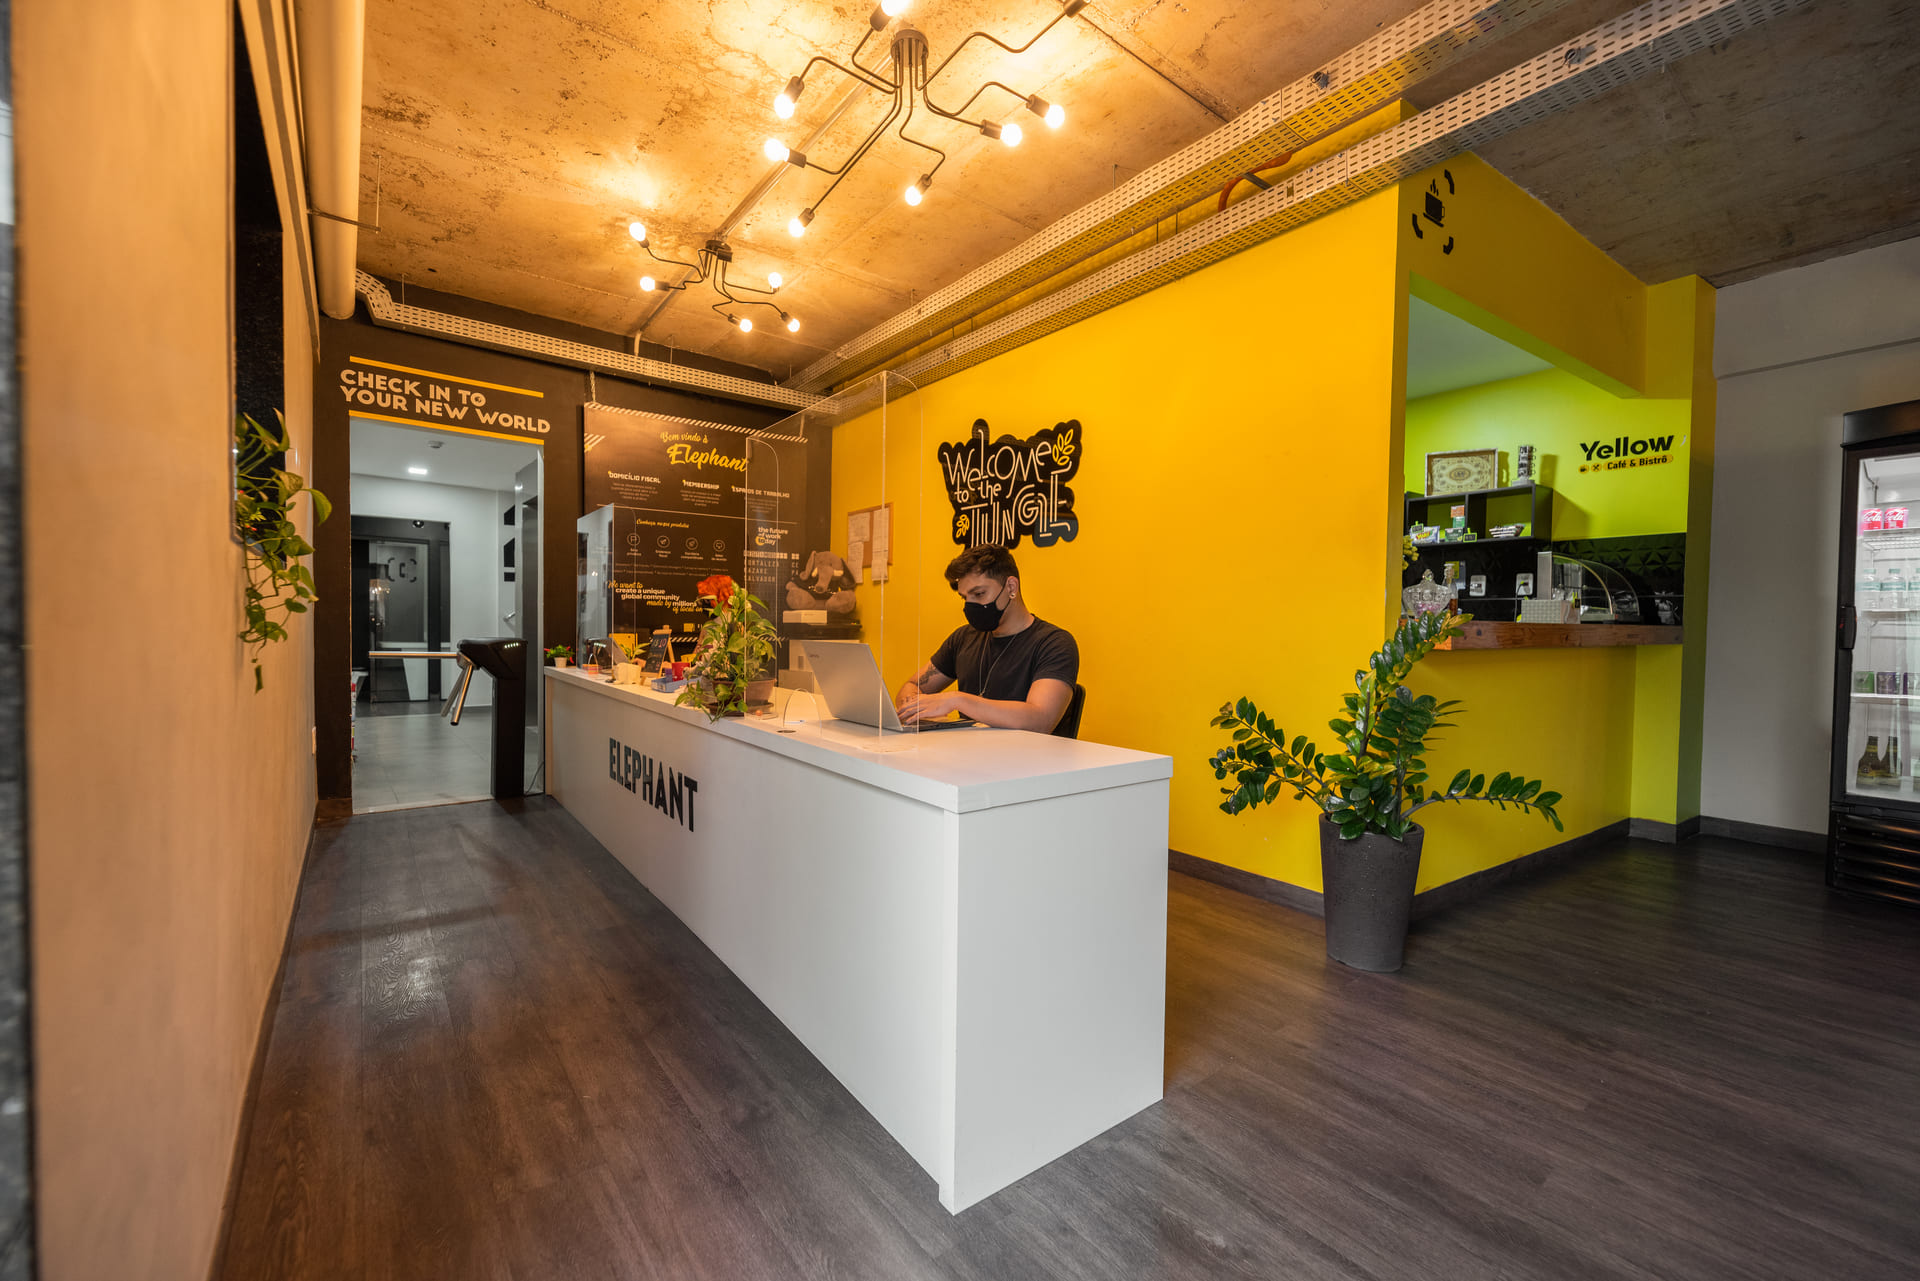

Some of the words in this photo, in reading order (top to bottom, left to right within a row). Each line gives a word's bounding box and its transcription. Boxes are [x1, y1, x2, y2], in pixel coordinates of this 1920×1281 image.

[340, 369, 422, 397] CHECK
[429, 384, 450, 402] IN
[458, 389, 487, 407] TO
[339, 385, 408, 411] YOUR
[415, 398, 469, 420] NEW
[475, 408, 550, 433] WORLD
[660, 431, 679, 443] Bom
[681, 432, 702, 442] vindo
[1580, 435, 1674, 461] Yellow
[666, 443, 748, 472] Elephant
[943, 429, 1051, 498] Welcome
[1607, 460, 1627, 470] Café
[1629, 459, 1637, 467] &
[1639, 455, 1667, 466] Bistrô
[609, 472, 640, 481] DOMICÍLIO
[641, 475, 661, 484] FISCAL
[683, 481, 719, 490] MEMBERSHIP
[954, 472, 969, 503] to
[978, 479, 1001, 504] the
[769, 527, 788, 535] future
[664, 600, 672, 608] by
[609, 737, 698, 832] ELEPHANT
